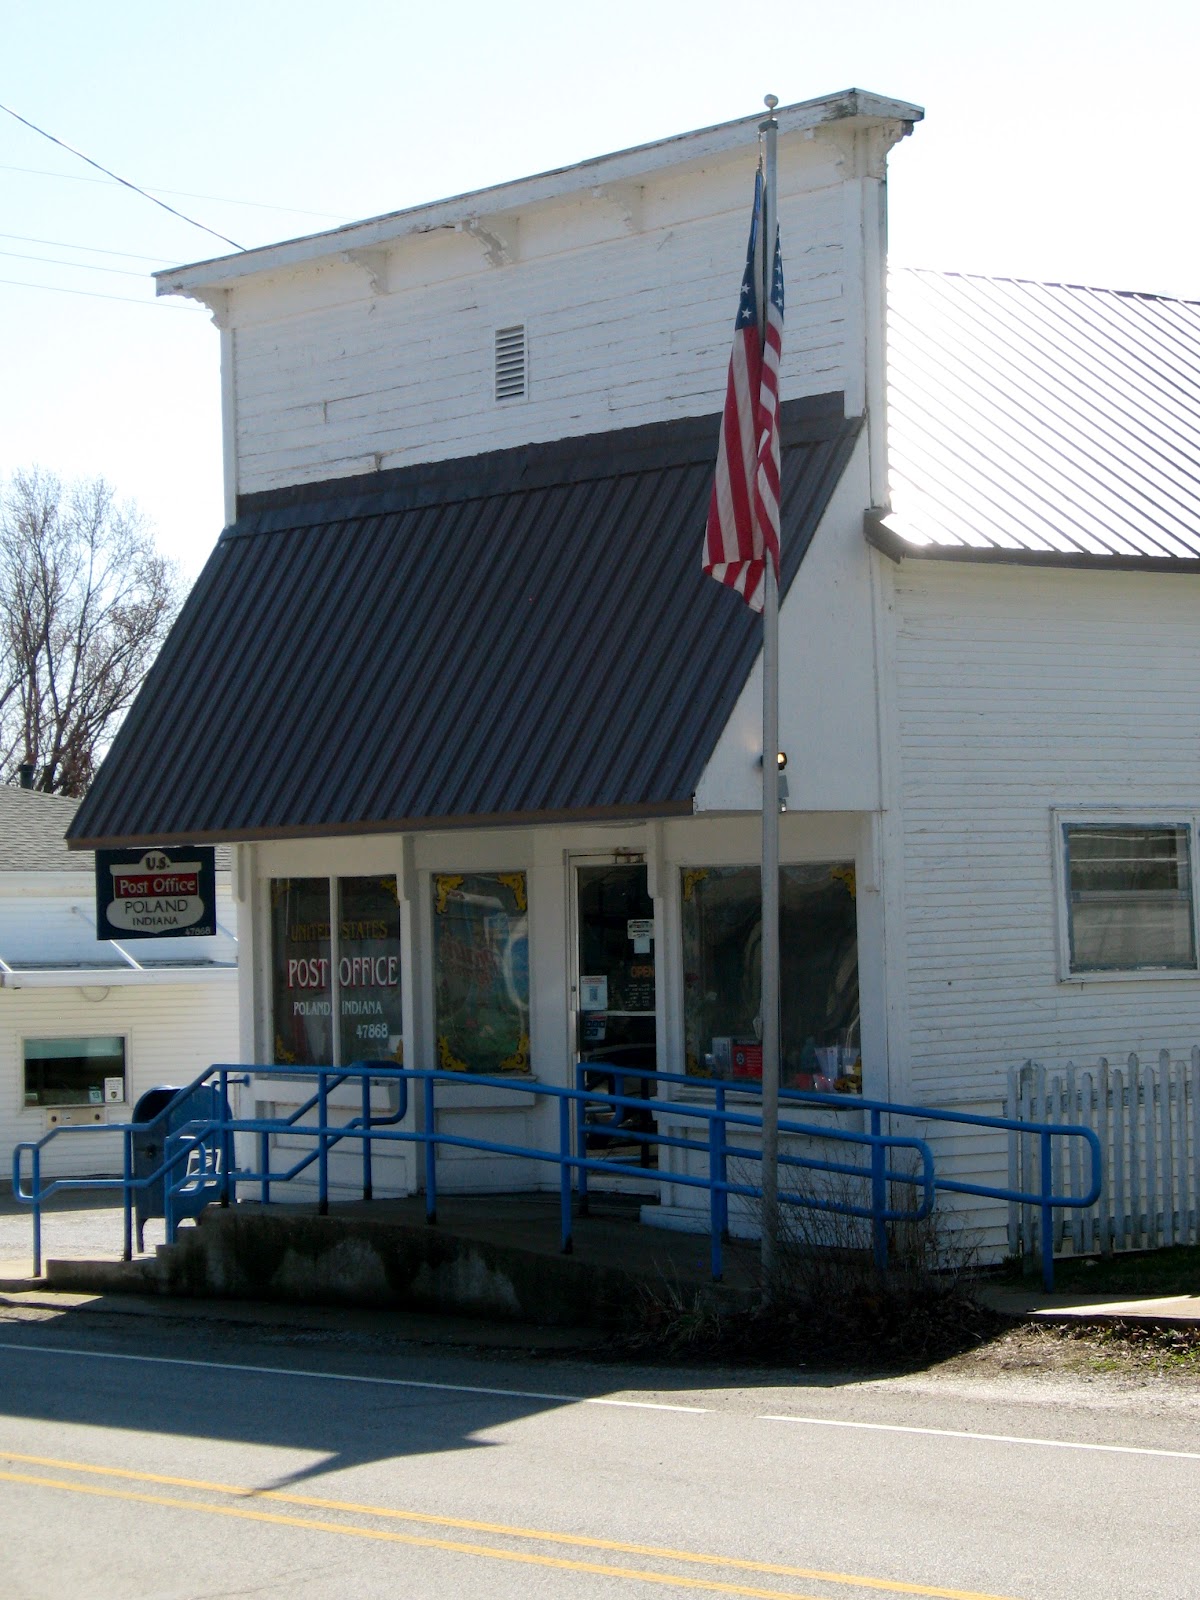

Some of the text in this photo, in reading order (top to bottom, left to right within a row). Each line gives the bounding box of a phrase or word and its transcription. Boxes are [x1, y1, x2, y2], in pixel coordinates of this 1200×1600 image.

[145, 857, 170, 871] U.S.
[120, 877, 195, 895] Post Office
[125, 900, 188, 914] POLAND
[132, 917, 179, 926] INDIANA
[184, 926, 211, 936] 47868
[342, 920, 388, 939] STATES
[287, 956, 398, 989] POST OFFICE
[342, 1001, 383, 1015] INDIANA
[355, 1023, 389, 1038] 47868
